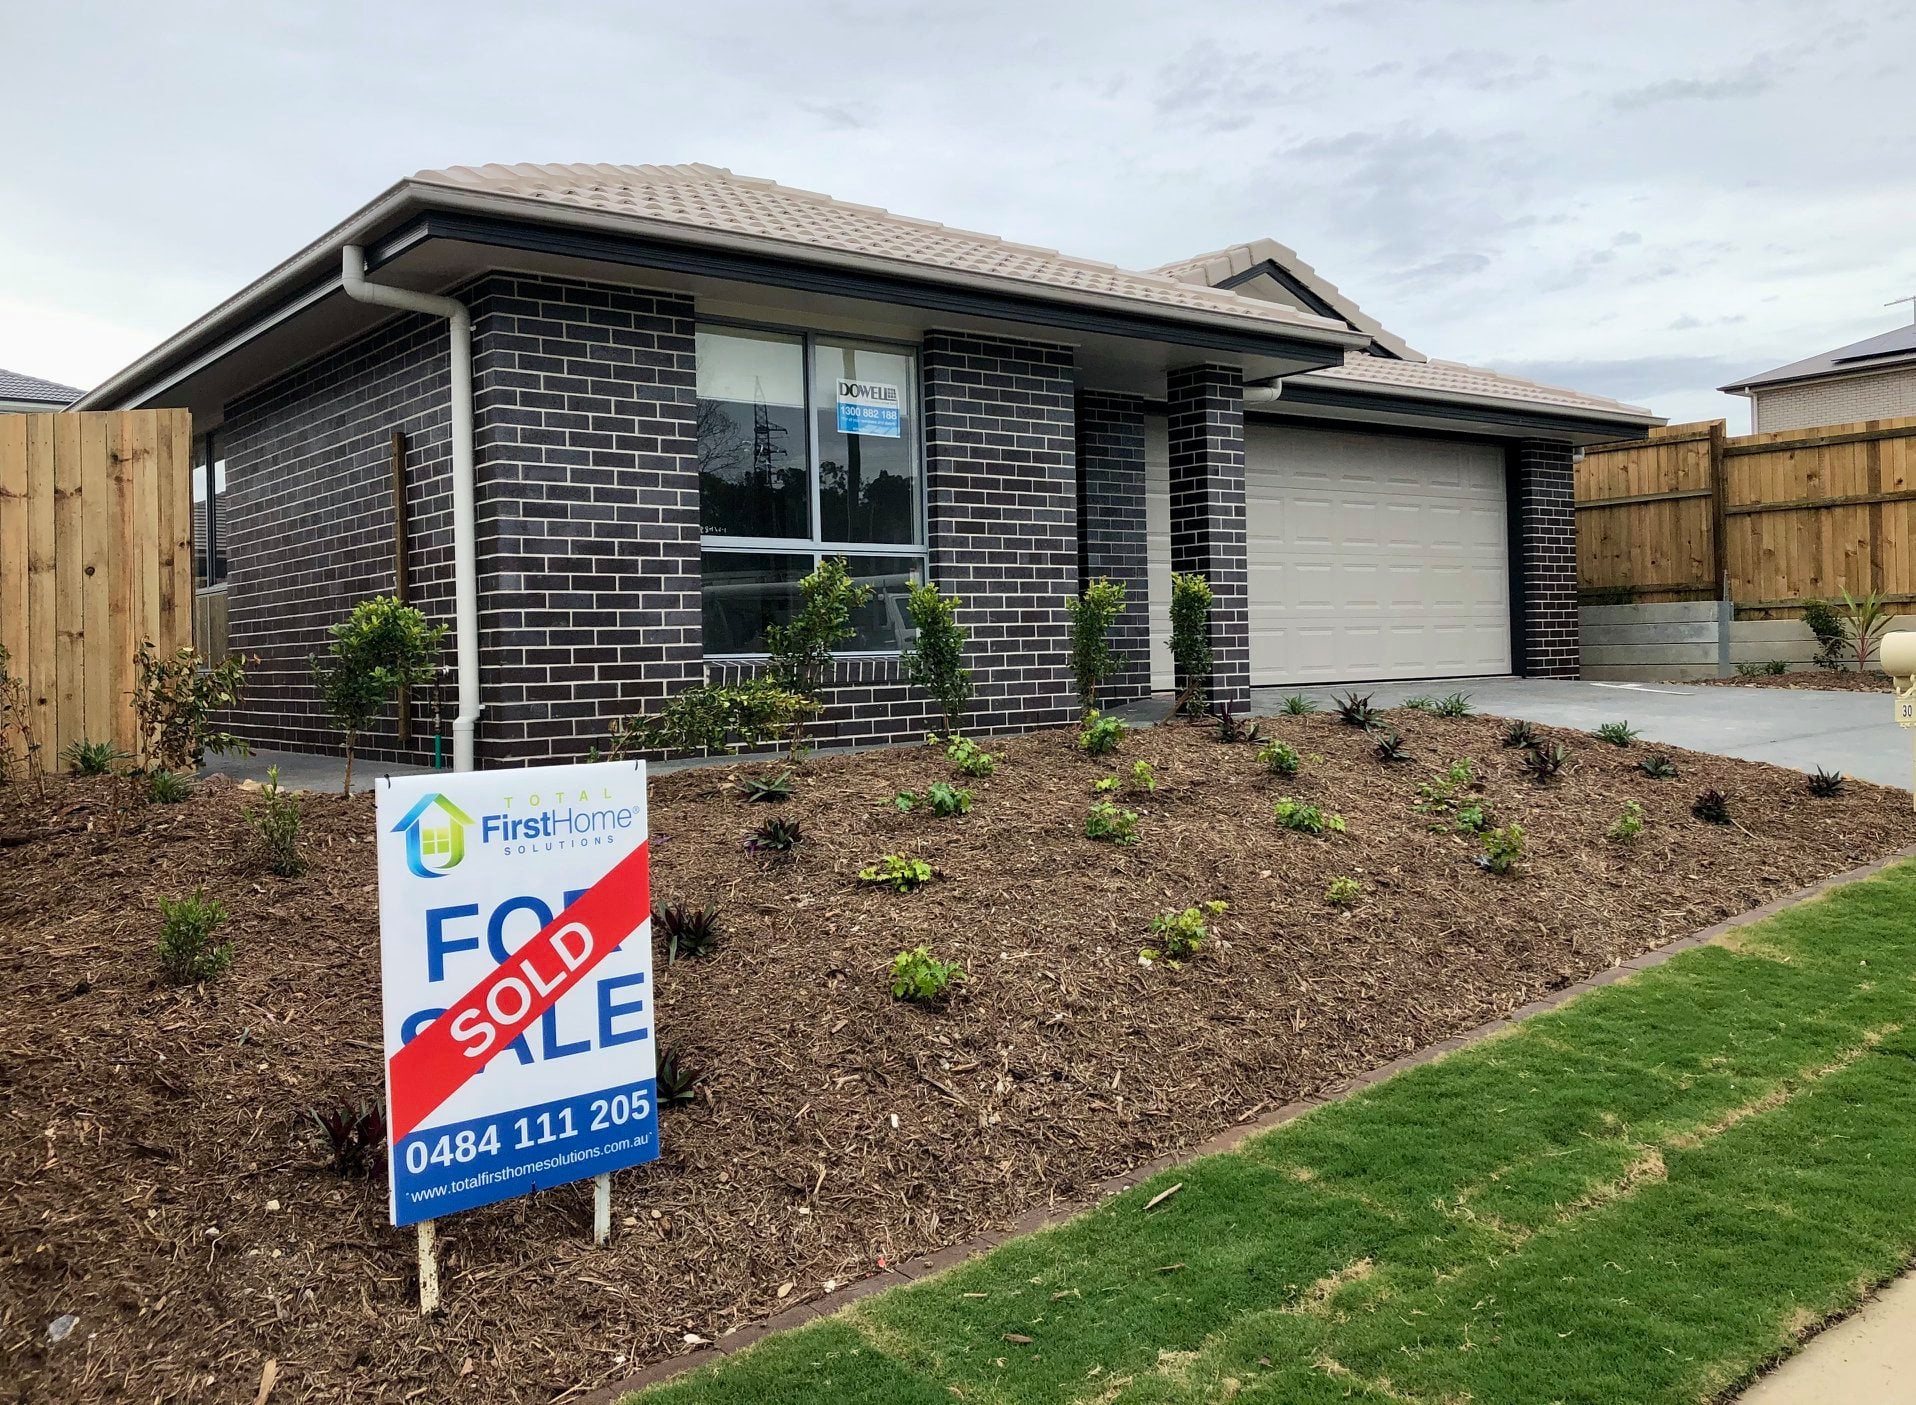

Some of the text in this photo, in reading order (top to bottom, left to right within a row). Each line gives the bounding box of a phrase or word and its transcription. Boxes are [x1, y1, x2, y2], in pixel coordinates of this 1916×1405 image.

[839, 382, 898, 401] DOWELL
[840, 405, 898, 420] 1300 882 188
[1902, 704, 1913, 718] 30
[503, 787, 612, 809] TOTAL
[504, 834, 614, 856] SOLUTIONS
[450, 921, 594, 1058] SOLD
[405, 1088, 651, 1175] 0484 111 205
[410, 1132, 650, 1204] www.totalfirsthomesolutions.com.au
